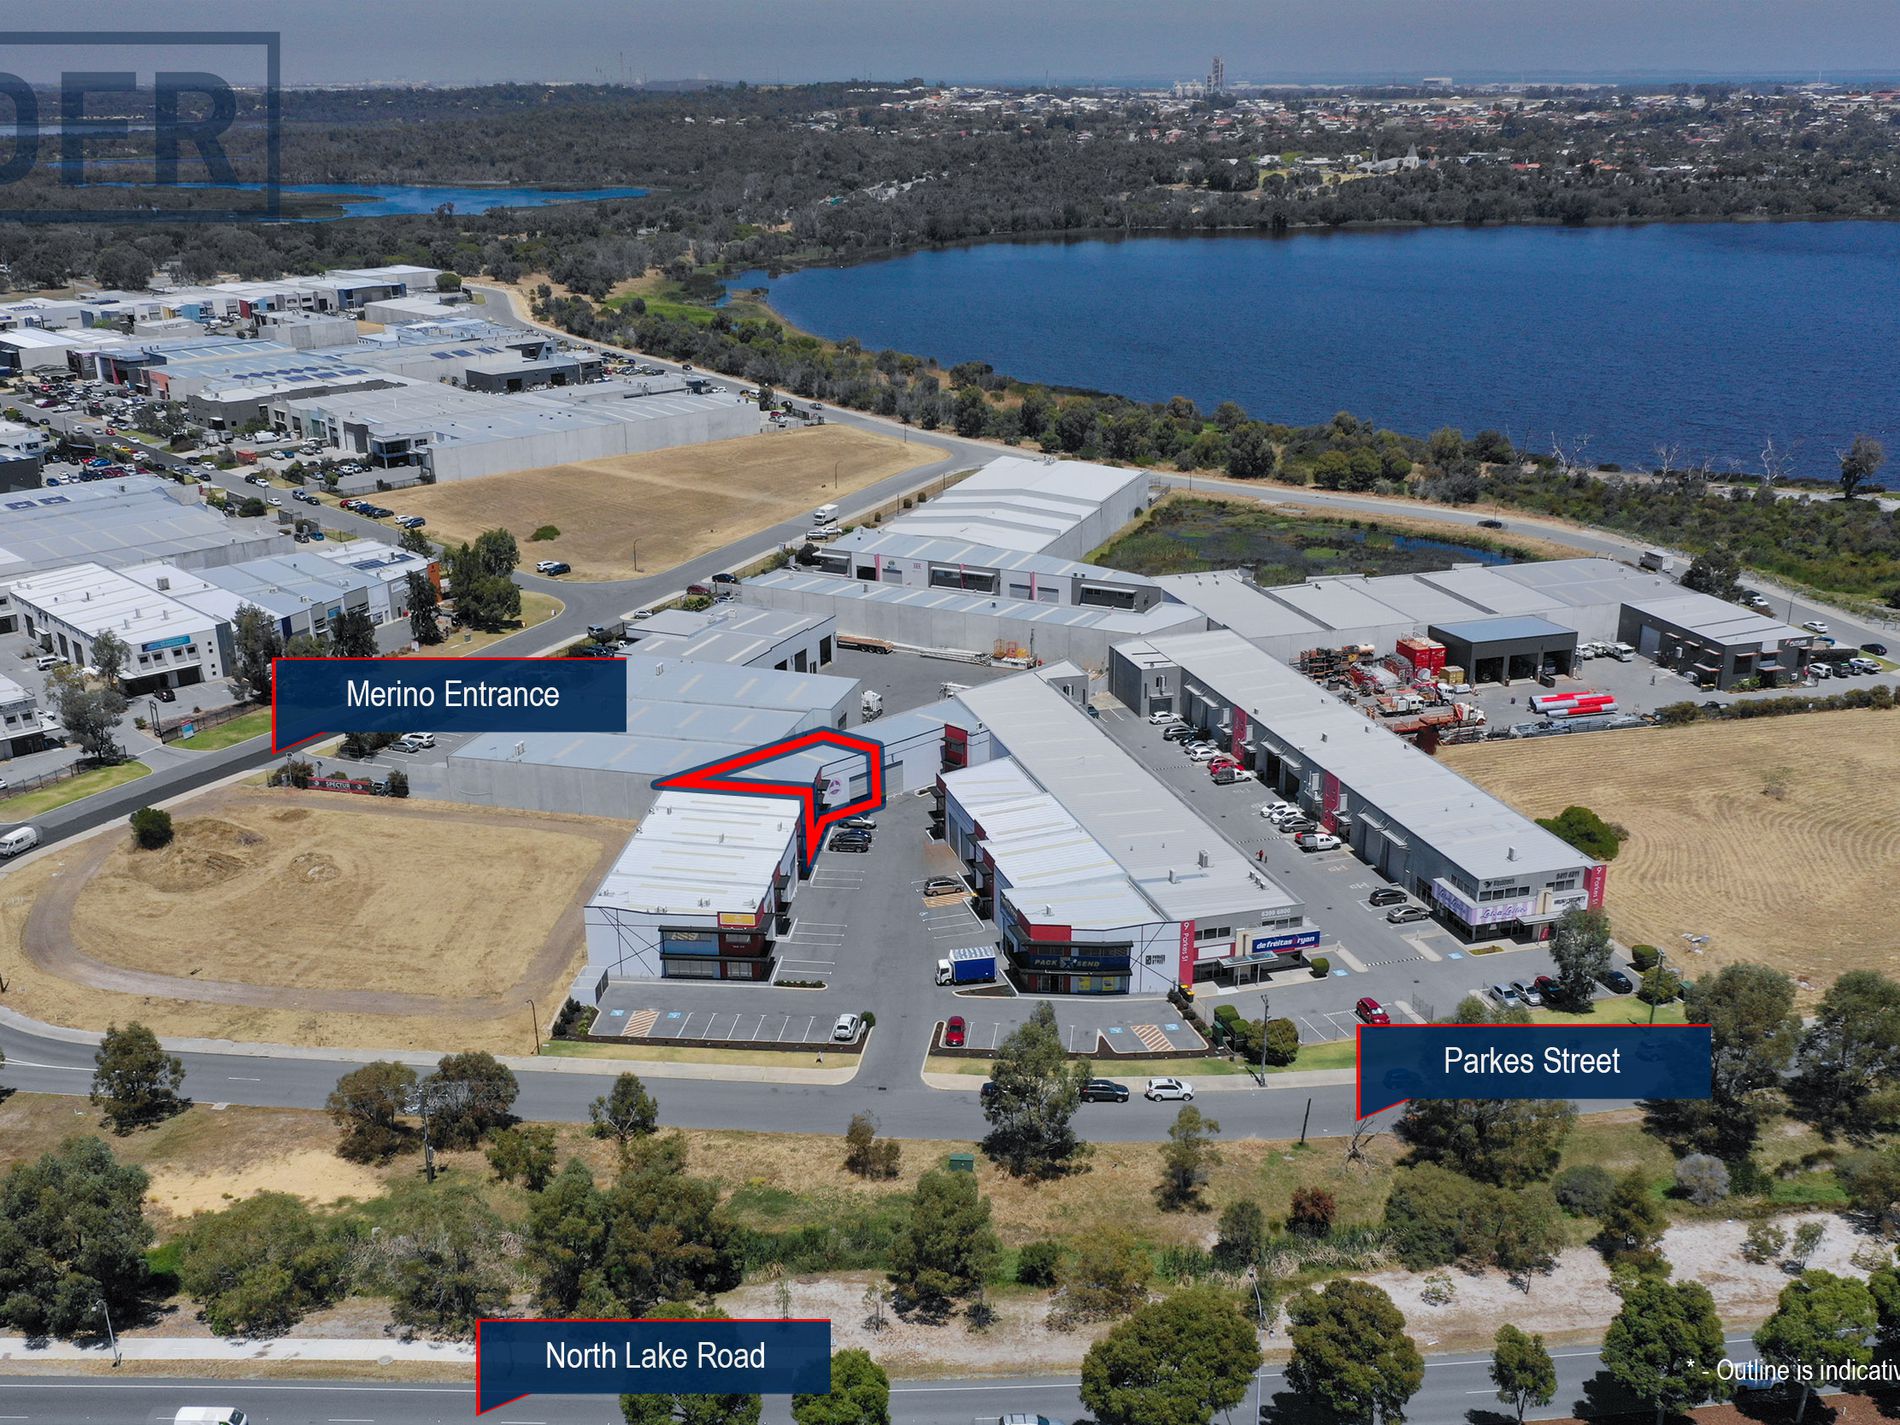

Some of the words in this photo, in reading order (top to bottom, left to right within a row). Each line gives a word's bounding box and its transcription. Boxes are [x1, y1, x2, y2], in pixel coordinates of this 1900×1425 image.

[1596, 866, 1602, 875] 9
[1183, 921, 1190, 931] 9
[1182, 933, 1190, 955] Parkes
[1034, 959, 1058, 967] PACK
